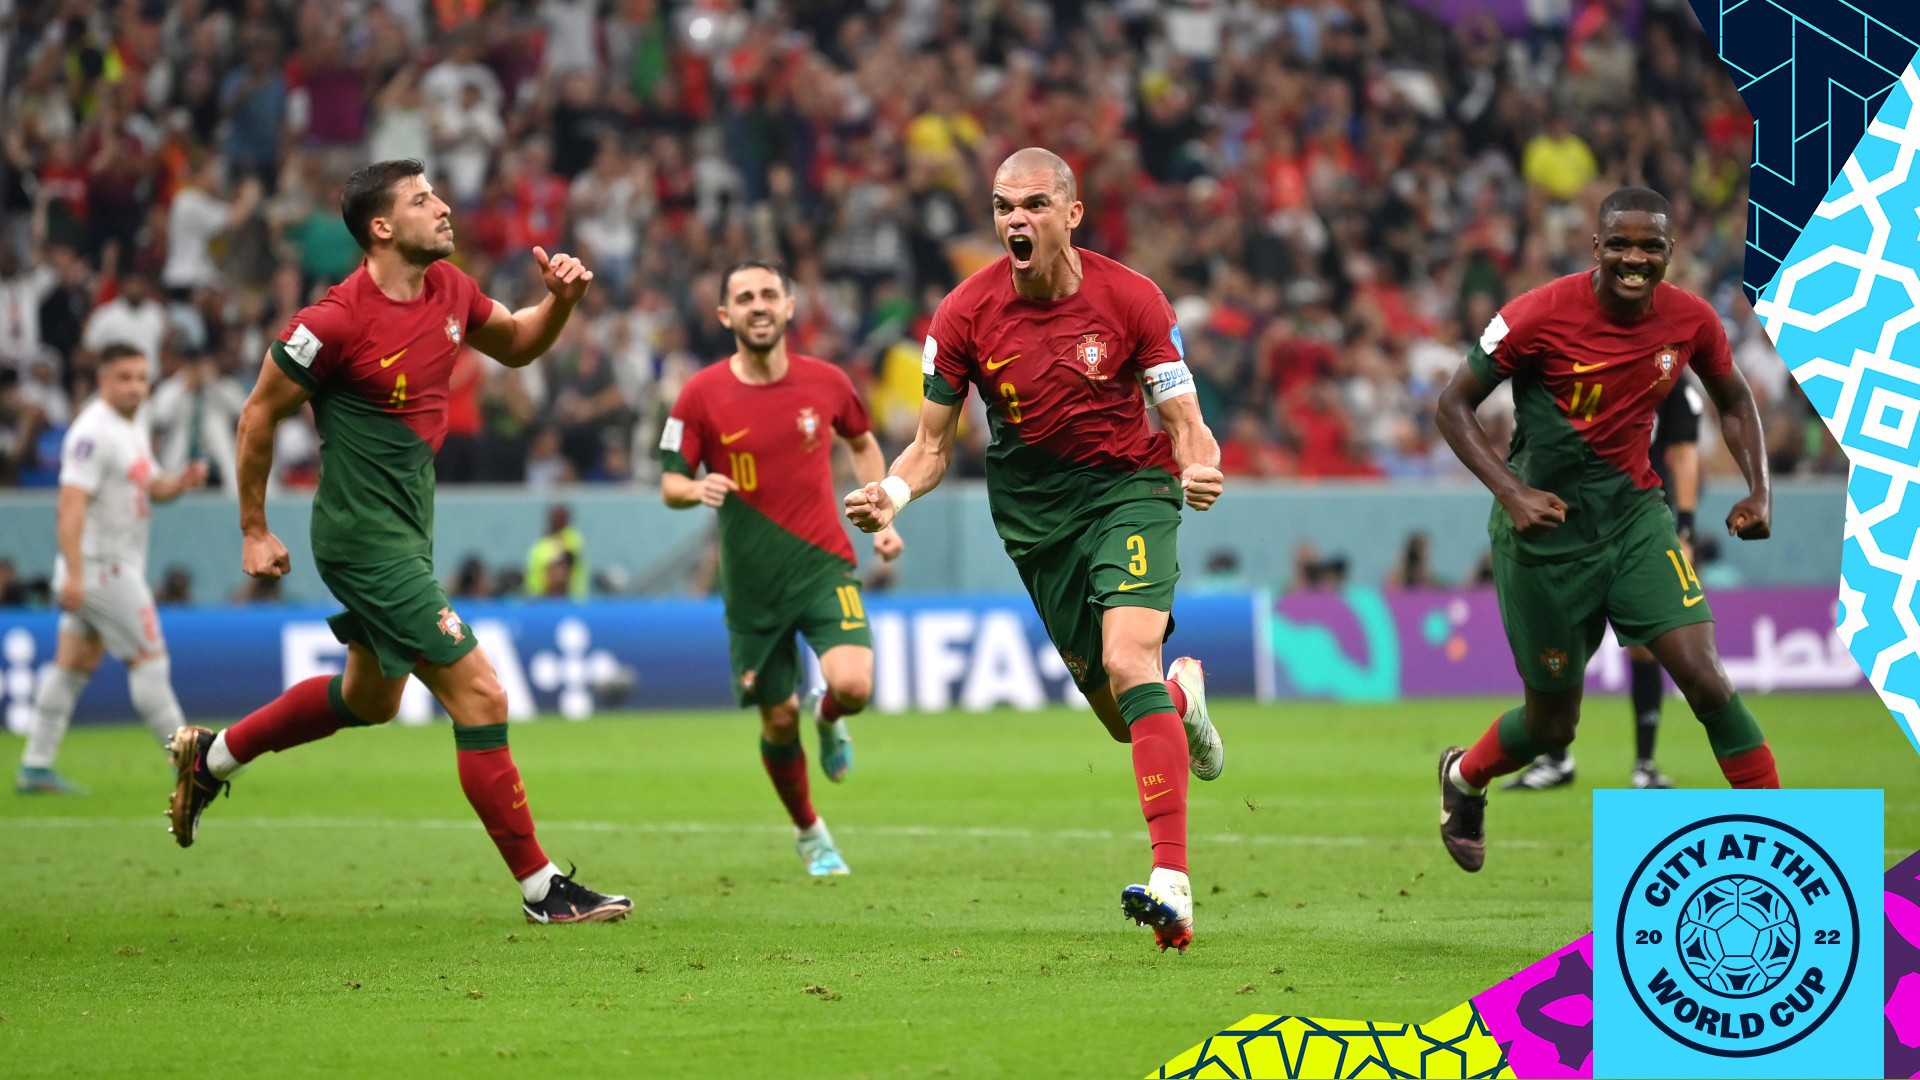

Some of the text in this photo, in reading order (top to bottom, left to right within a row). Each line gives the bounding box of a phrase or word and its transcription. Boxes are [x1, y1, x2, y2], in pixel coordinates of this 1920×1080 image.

[389, 373, 406, 409] 4
[1568, 381, 1602, 422] 14
[729, 452, 757, 491] 10
[1126, 535, 1148, 576] 3
[1666, 549, 1702, 591] 14
[836, 585, 865, 620] 10
